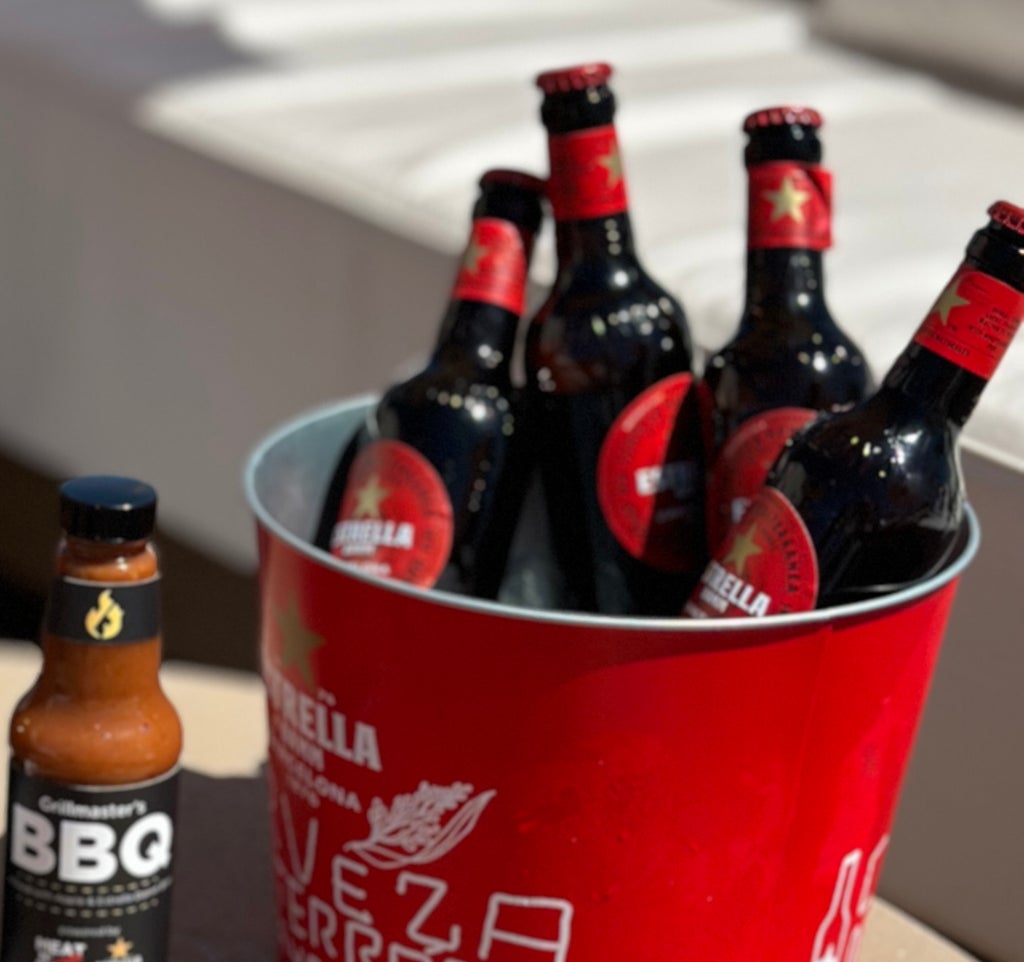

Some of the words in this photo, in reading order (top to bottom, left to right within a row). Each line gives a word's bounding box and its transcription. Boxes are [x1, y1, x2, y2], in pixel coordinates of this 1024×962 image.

[268, 668, 383, 773] RELLA
[10, 801, 174, 884] BBQ
[37, 794, 148, 820] Grillmaster's
